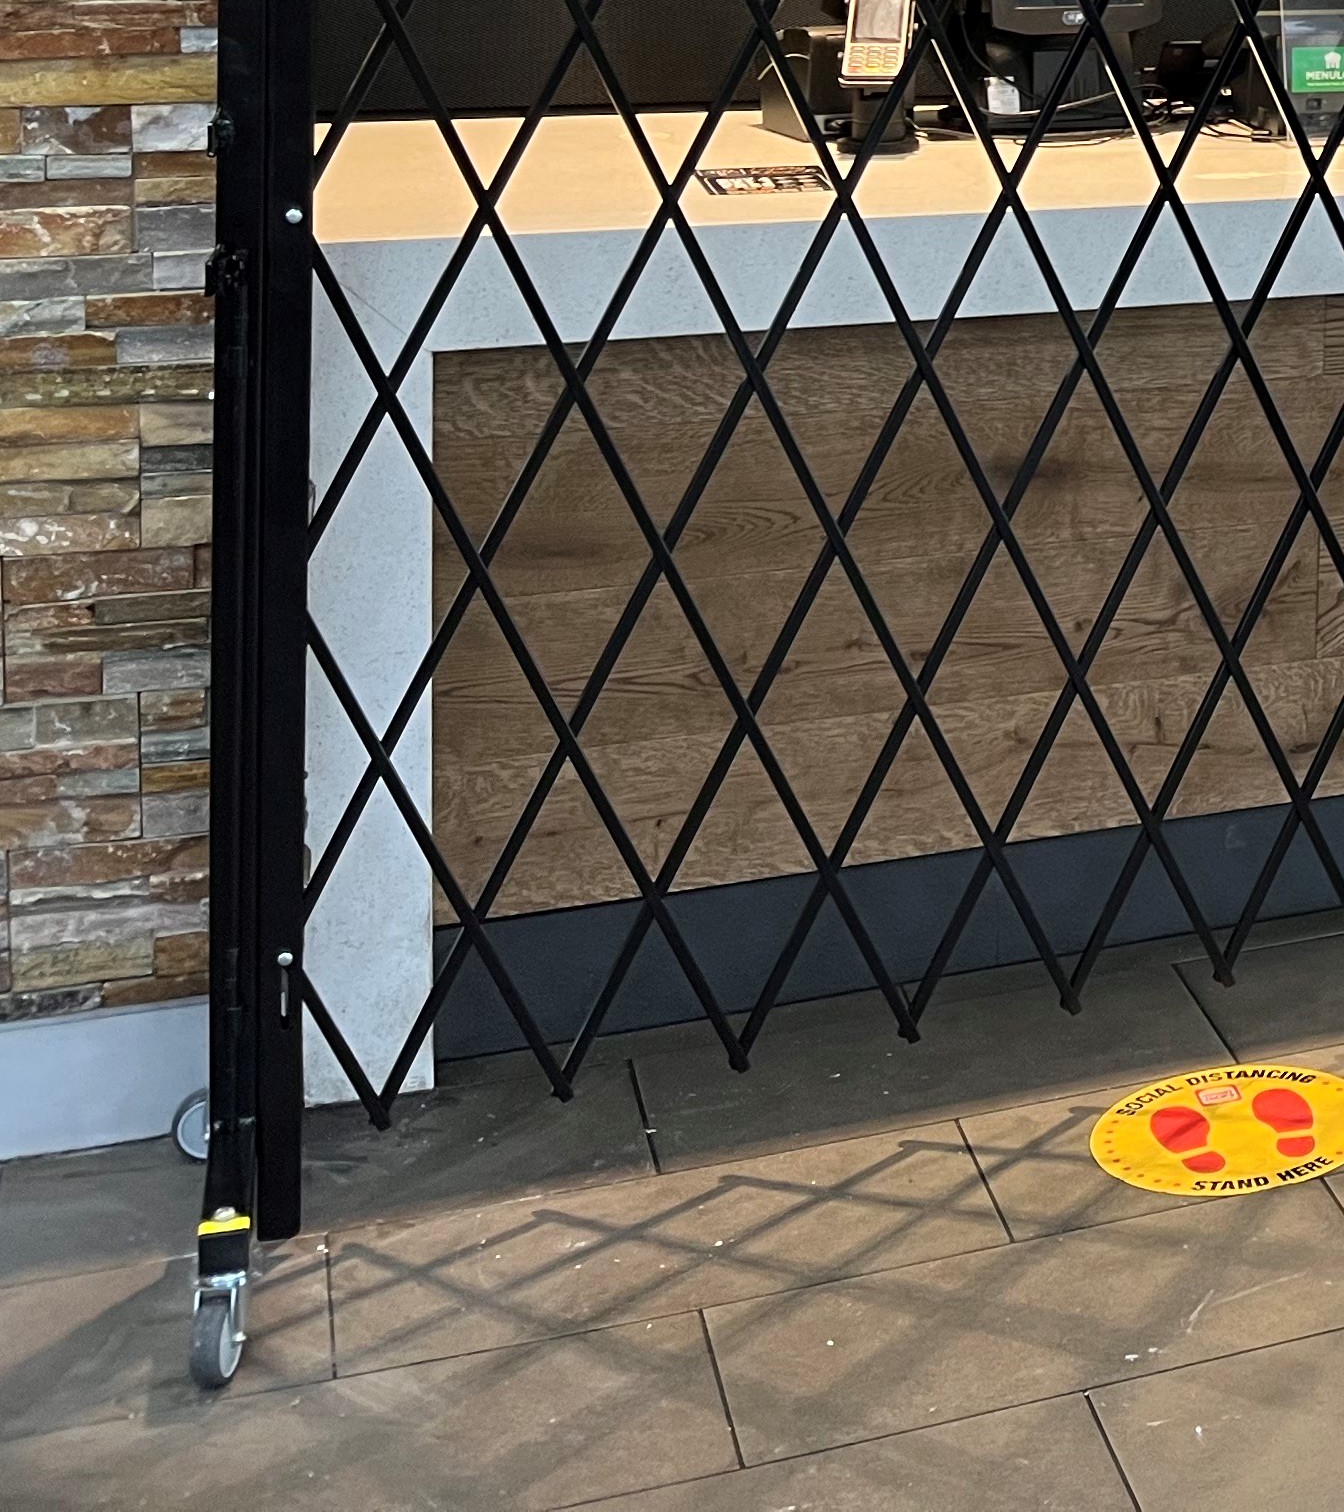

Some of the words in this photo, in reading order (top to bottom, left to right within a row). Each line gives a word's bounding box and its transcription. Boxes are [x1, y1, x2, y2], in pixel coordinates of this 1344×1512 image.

[1116, 1084, 1182, 1117] SOCIAL
[1186, 1069, 1317, 1085] DISTANCING
[1191, 1176, 1269, 1192] STAND
[1276, 1156, 1334, 1183] HERE
